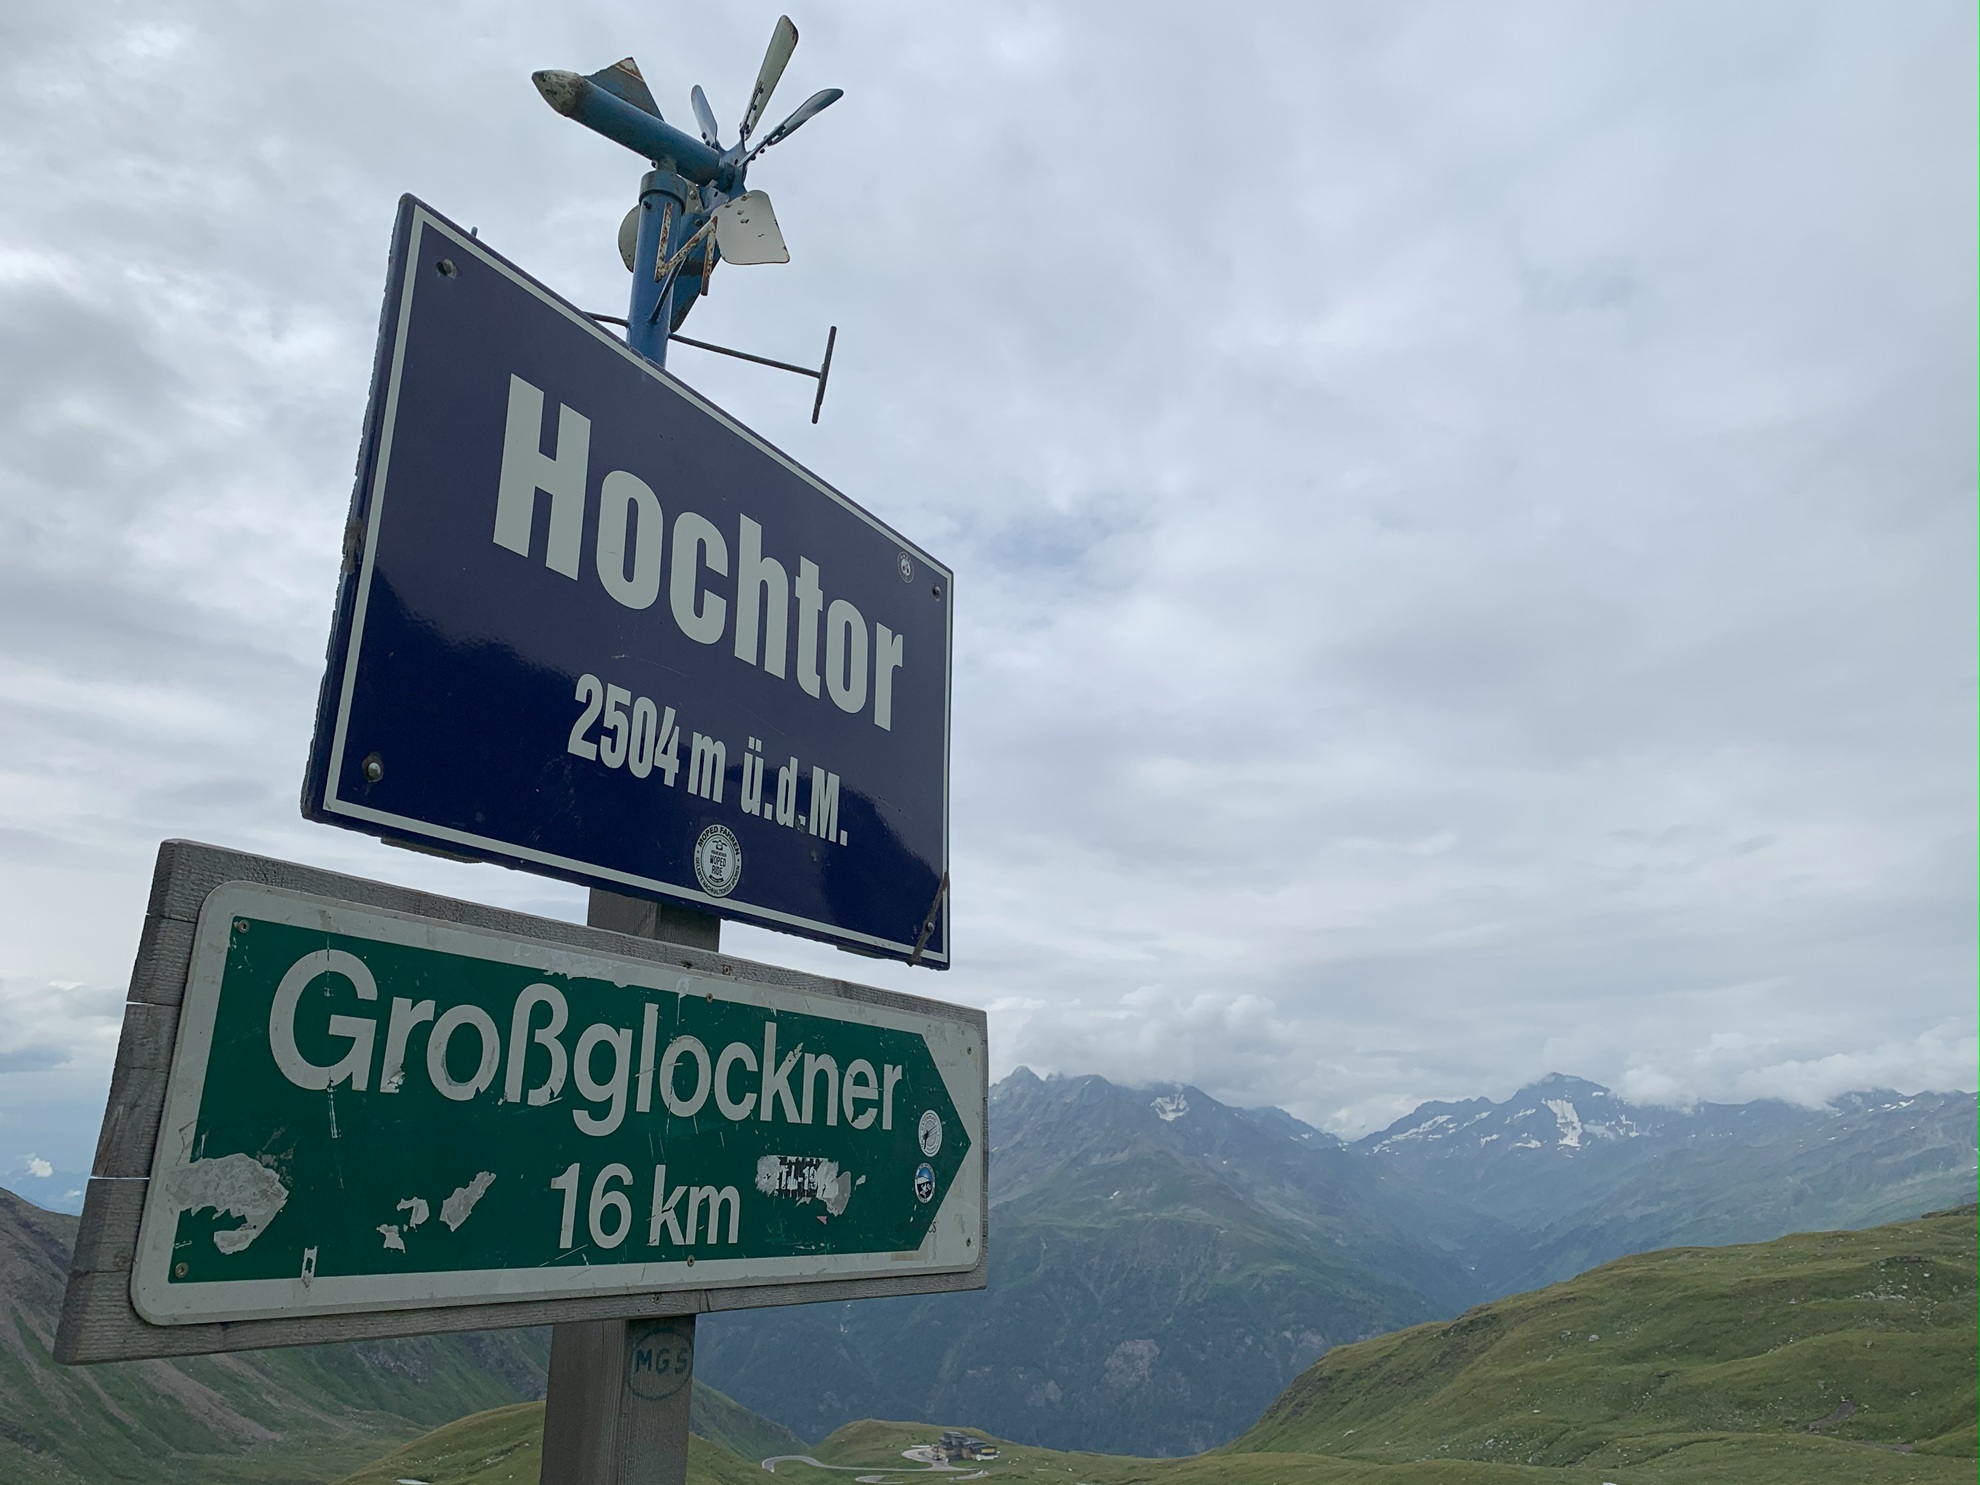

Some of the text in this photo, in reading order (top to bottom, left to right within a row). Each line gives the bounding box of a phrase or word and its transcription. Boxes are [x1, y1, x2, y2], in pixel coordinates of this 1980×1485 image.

[493, 373, 903, 732] Hochtor
[567, 673, 680, 787] 2504
[687, 731, 727, 804] m
[698, 826, 740, 856] MOPED FAHREN
[269, 949, 903, 1136] Großglockner
[551, 1163, 741, 1249] 16 km
